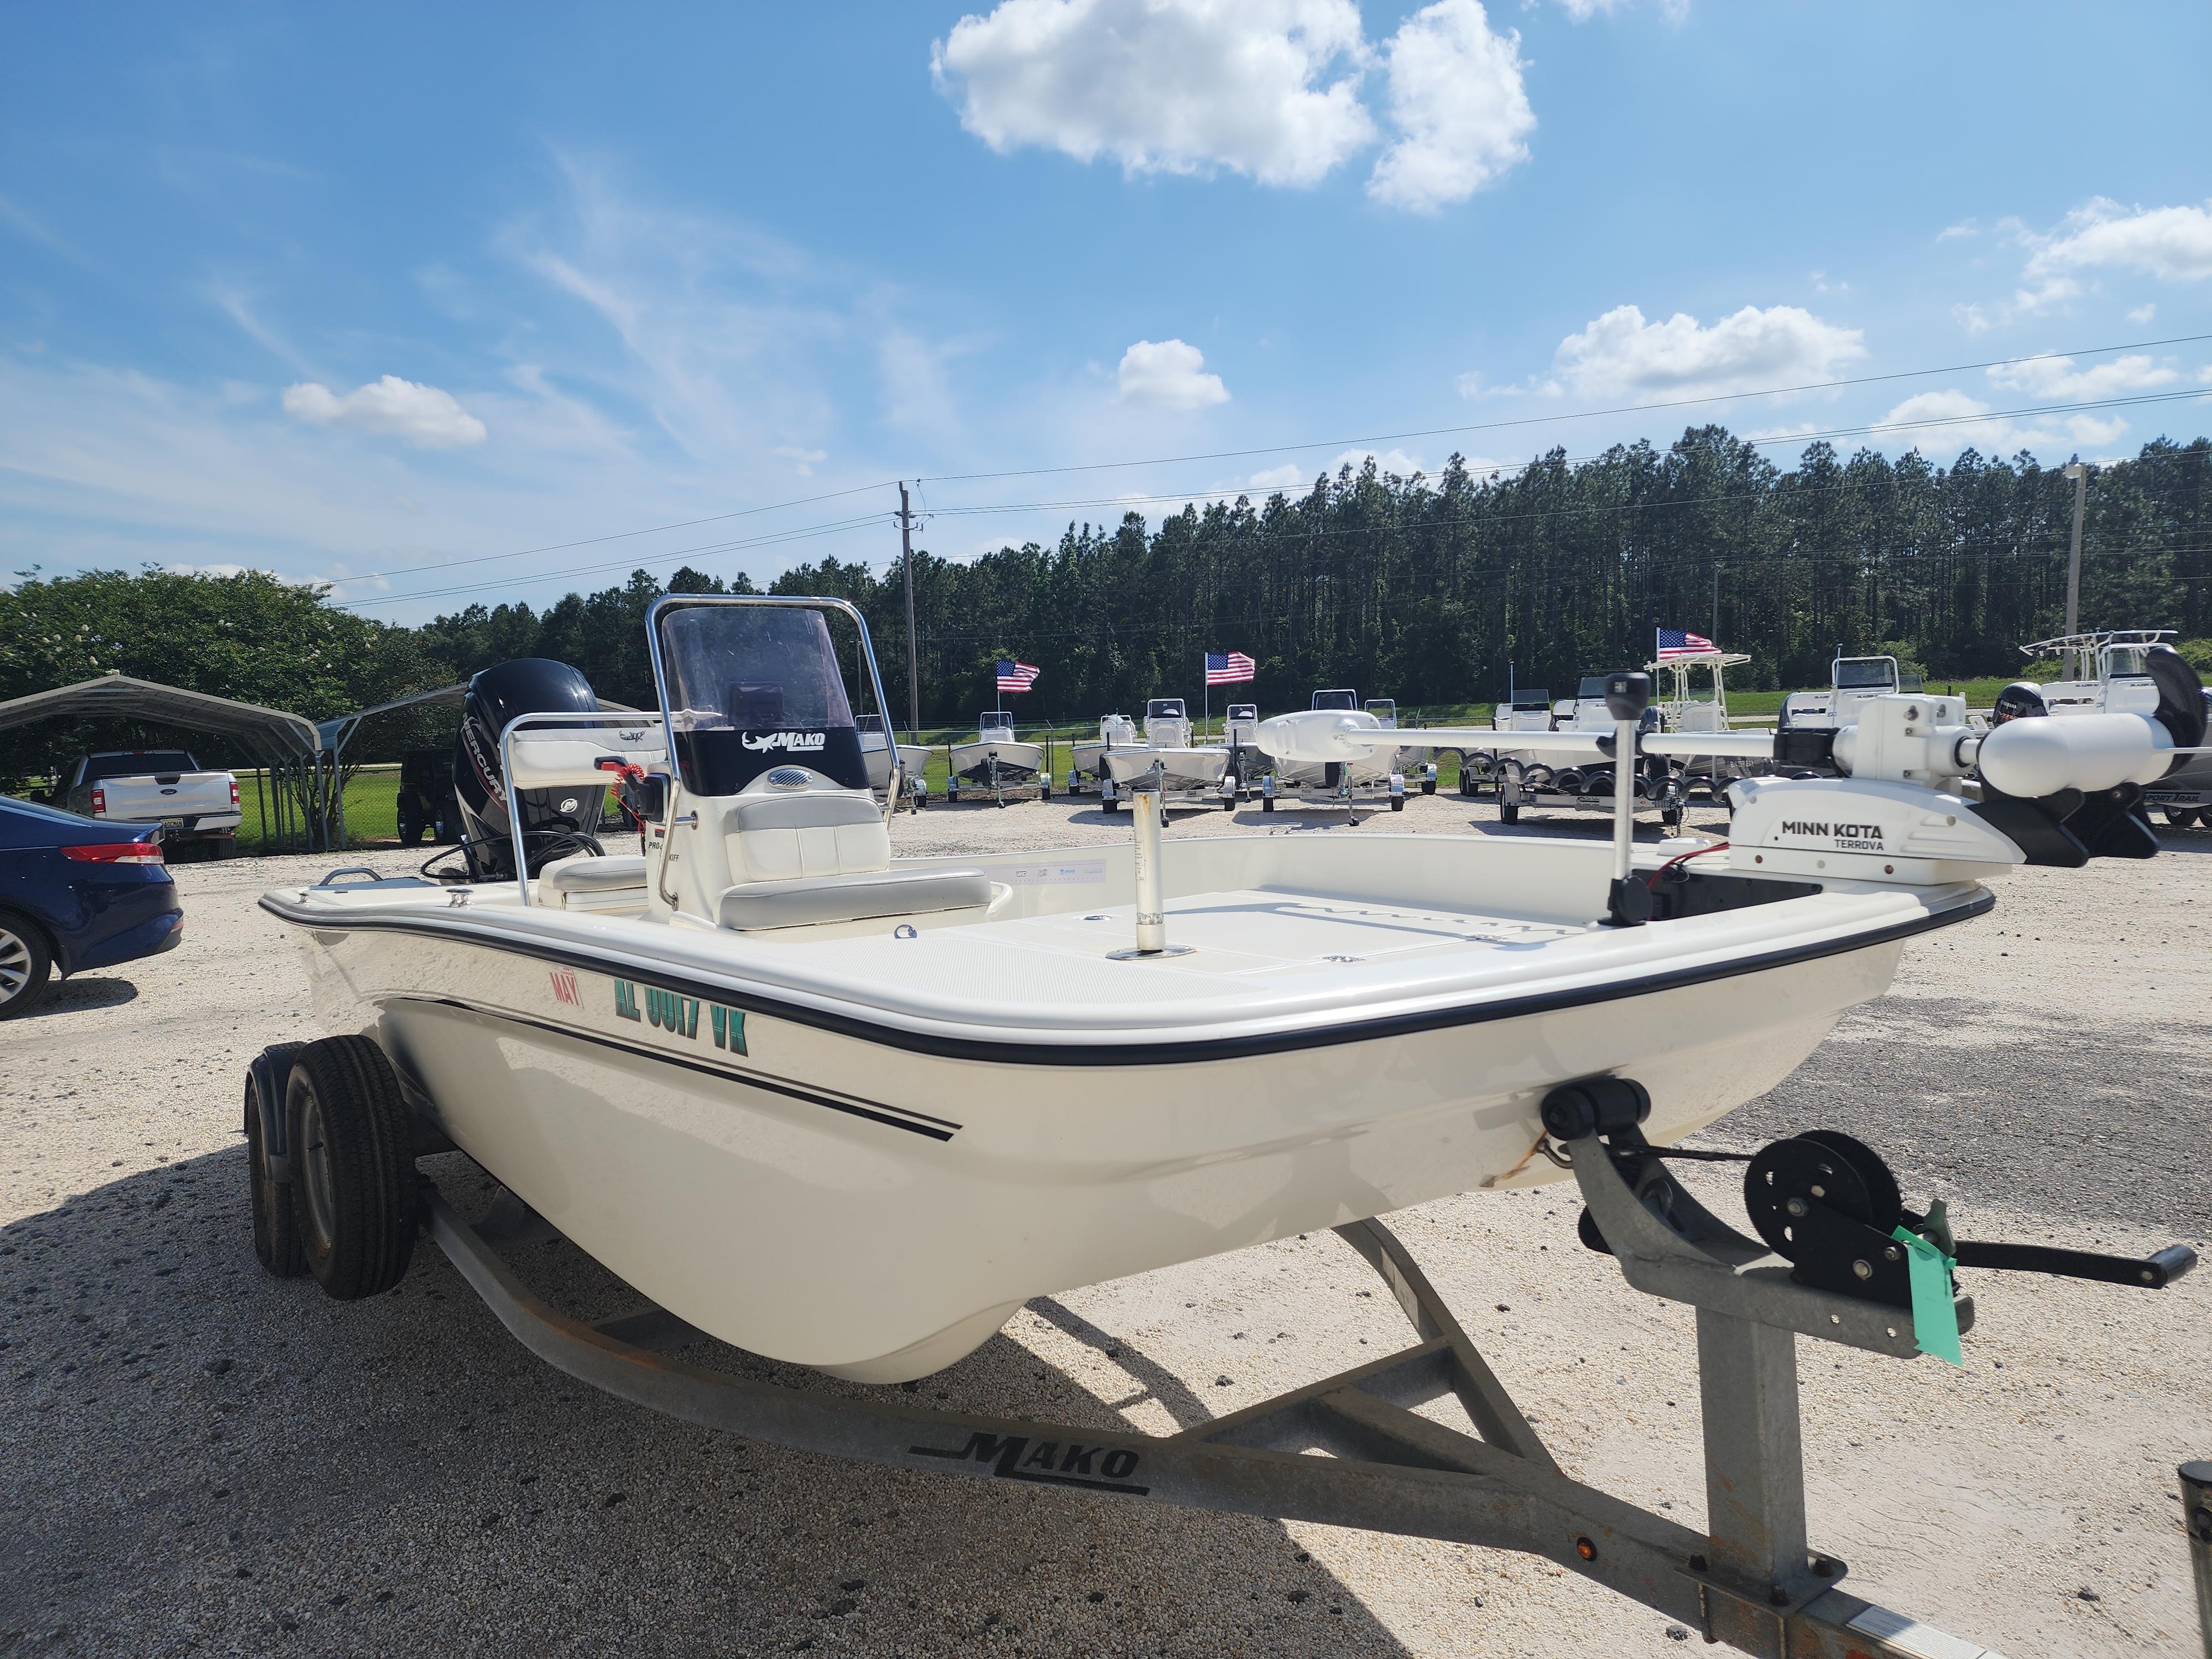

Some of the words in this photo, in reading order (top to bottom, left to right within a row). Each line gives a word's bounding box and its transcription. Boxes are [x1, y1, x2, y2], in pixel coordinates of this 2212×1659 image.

[771, 732, 826, 752] MAKO
[462, 712, 507, 802] MERCURY
[2173, 792, 2200, 802] TRAIL
[1782, 821, 1829, 836] MINN
[1834, 823, 1883, 839] KOTA
[1834, 839, 1884, 851] TERROVA
[549, 972, 579, 1005] MAY
[614, 979, 641, 1022] AL
[907, 1432, 1150, 1496] MAKO
